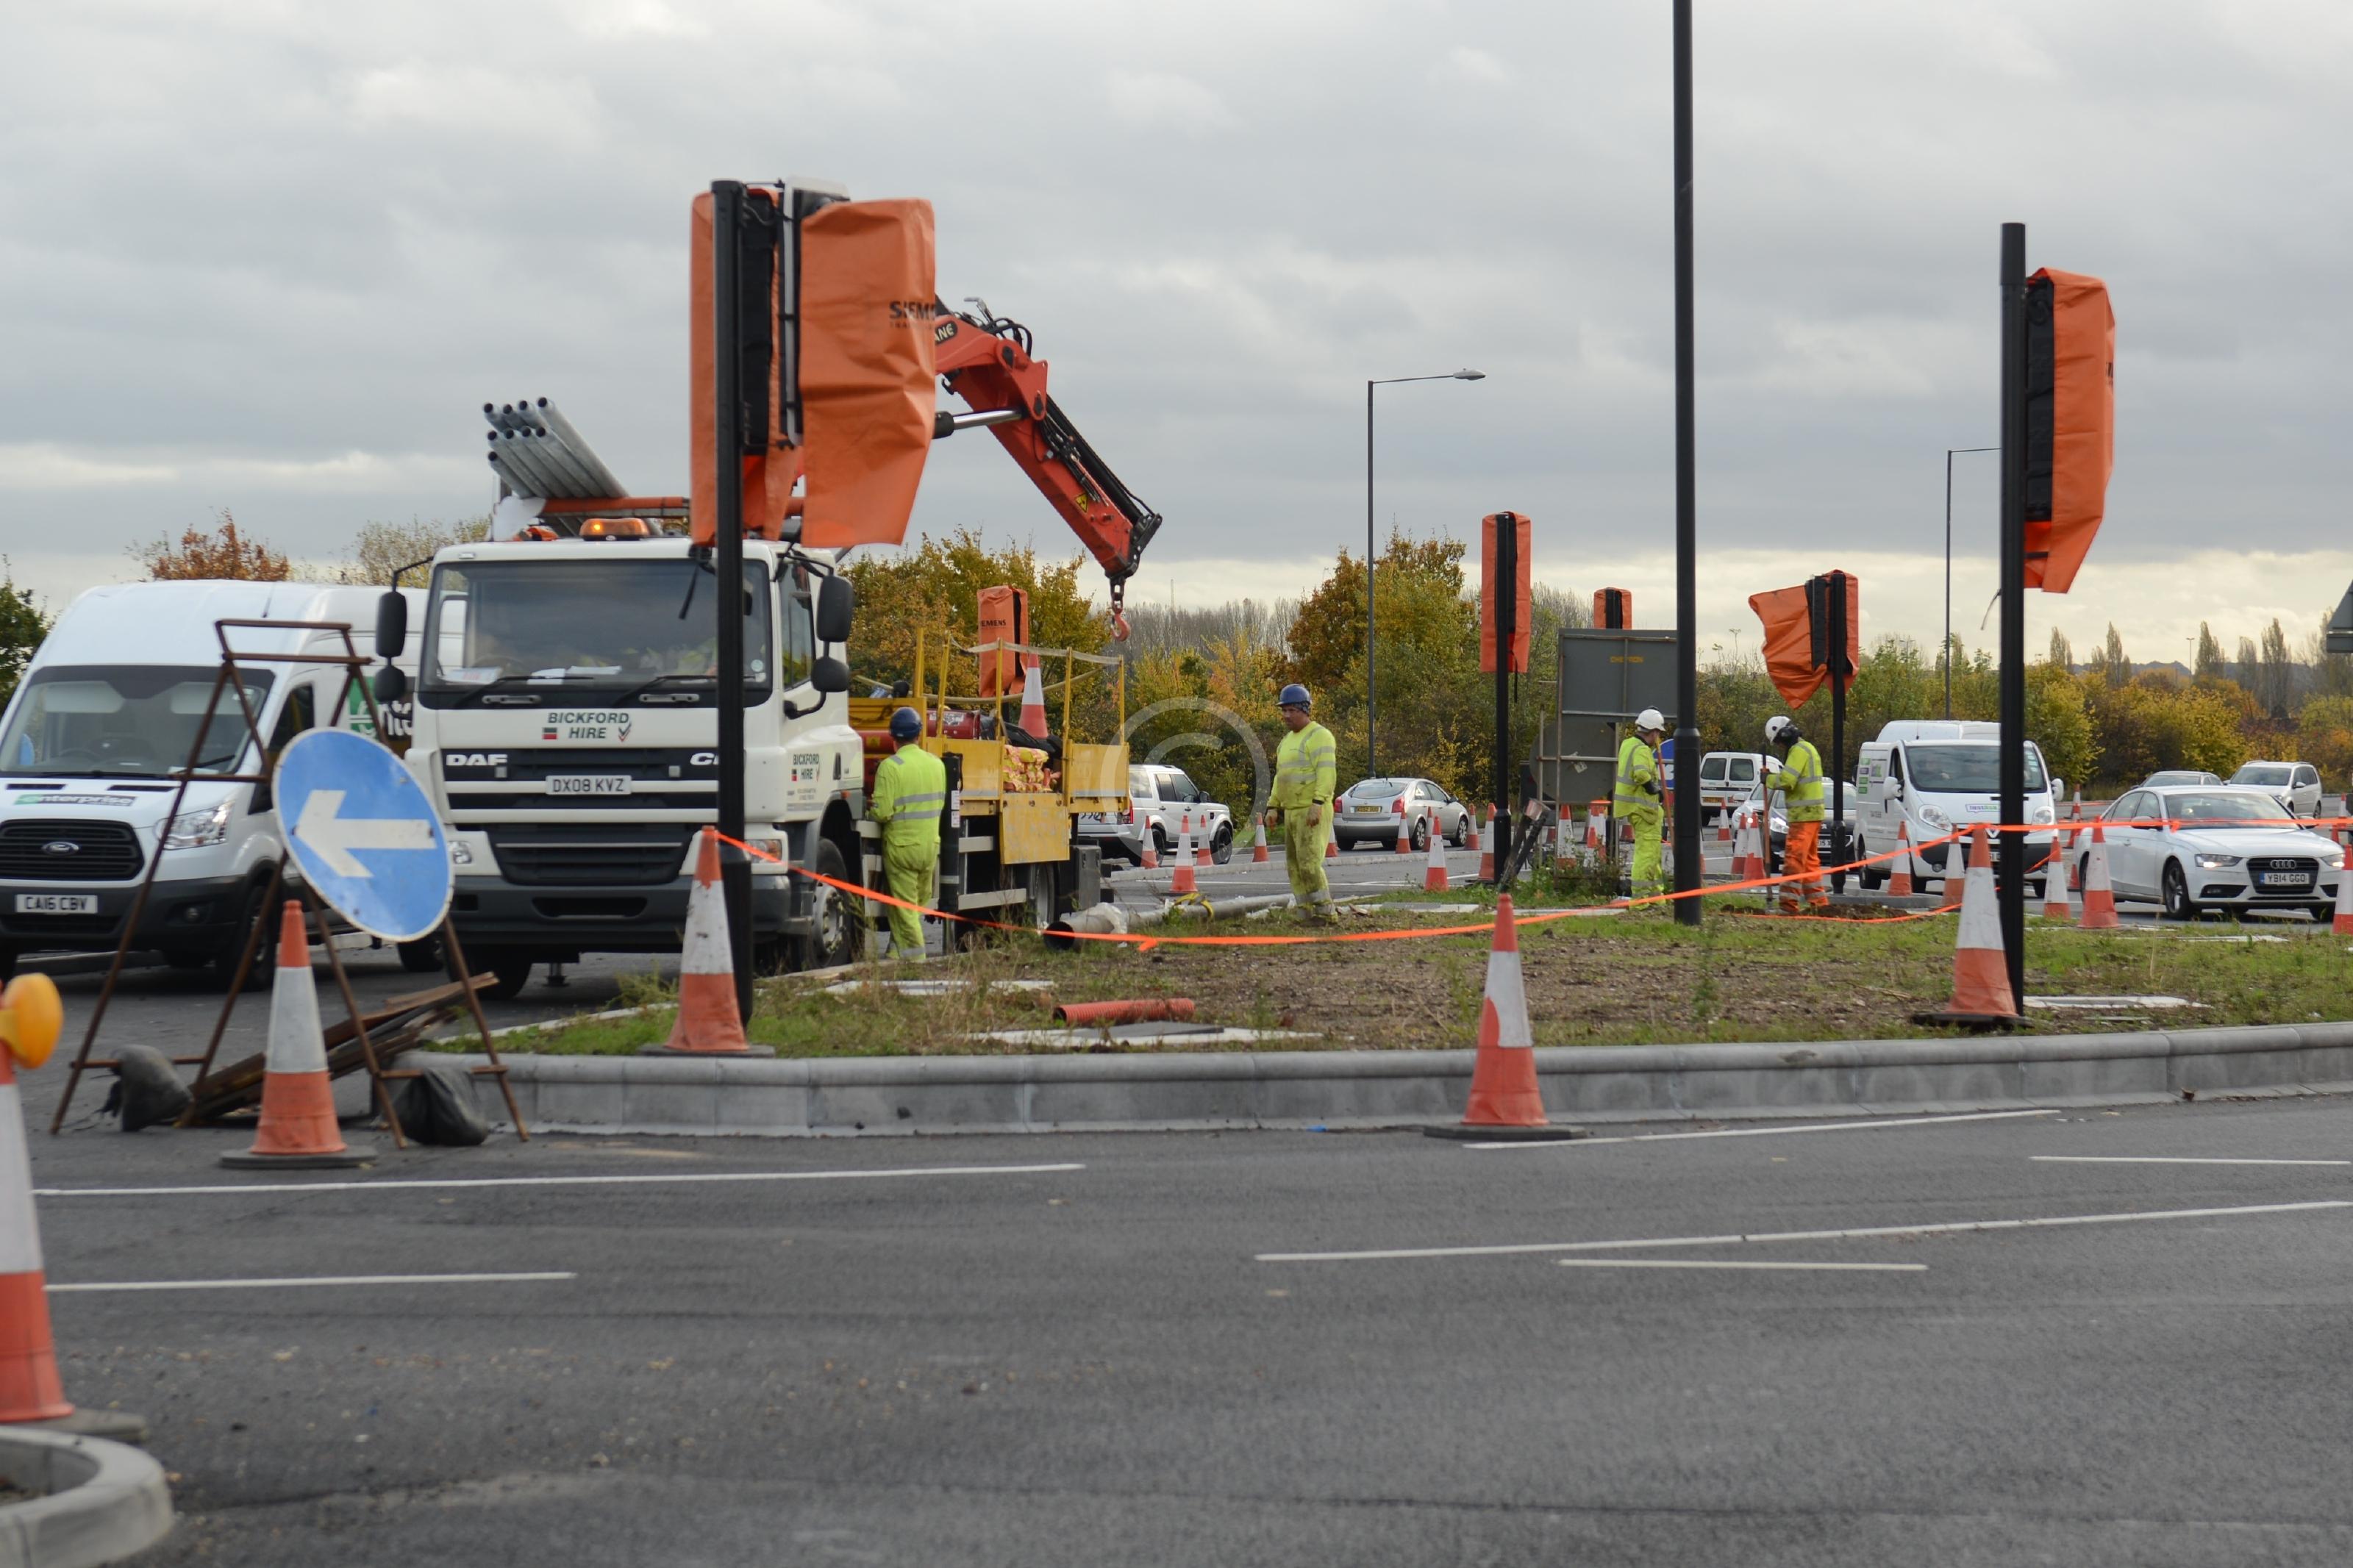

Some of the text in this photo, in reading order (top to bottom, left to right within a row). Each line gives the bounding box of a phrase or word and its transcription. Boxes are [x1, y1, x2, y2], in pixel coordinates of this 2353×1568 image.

[548, 713, 629, 724] BICKFORD
[568, 727, 607, 739] HIRE
[446, 753, 718, 766] DAF C
[793, 753, 819, 765] BICKFORD
[801, 768, 813, 780] HIRE
[552, 779, 625, 792] DX08 KVZ
